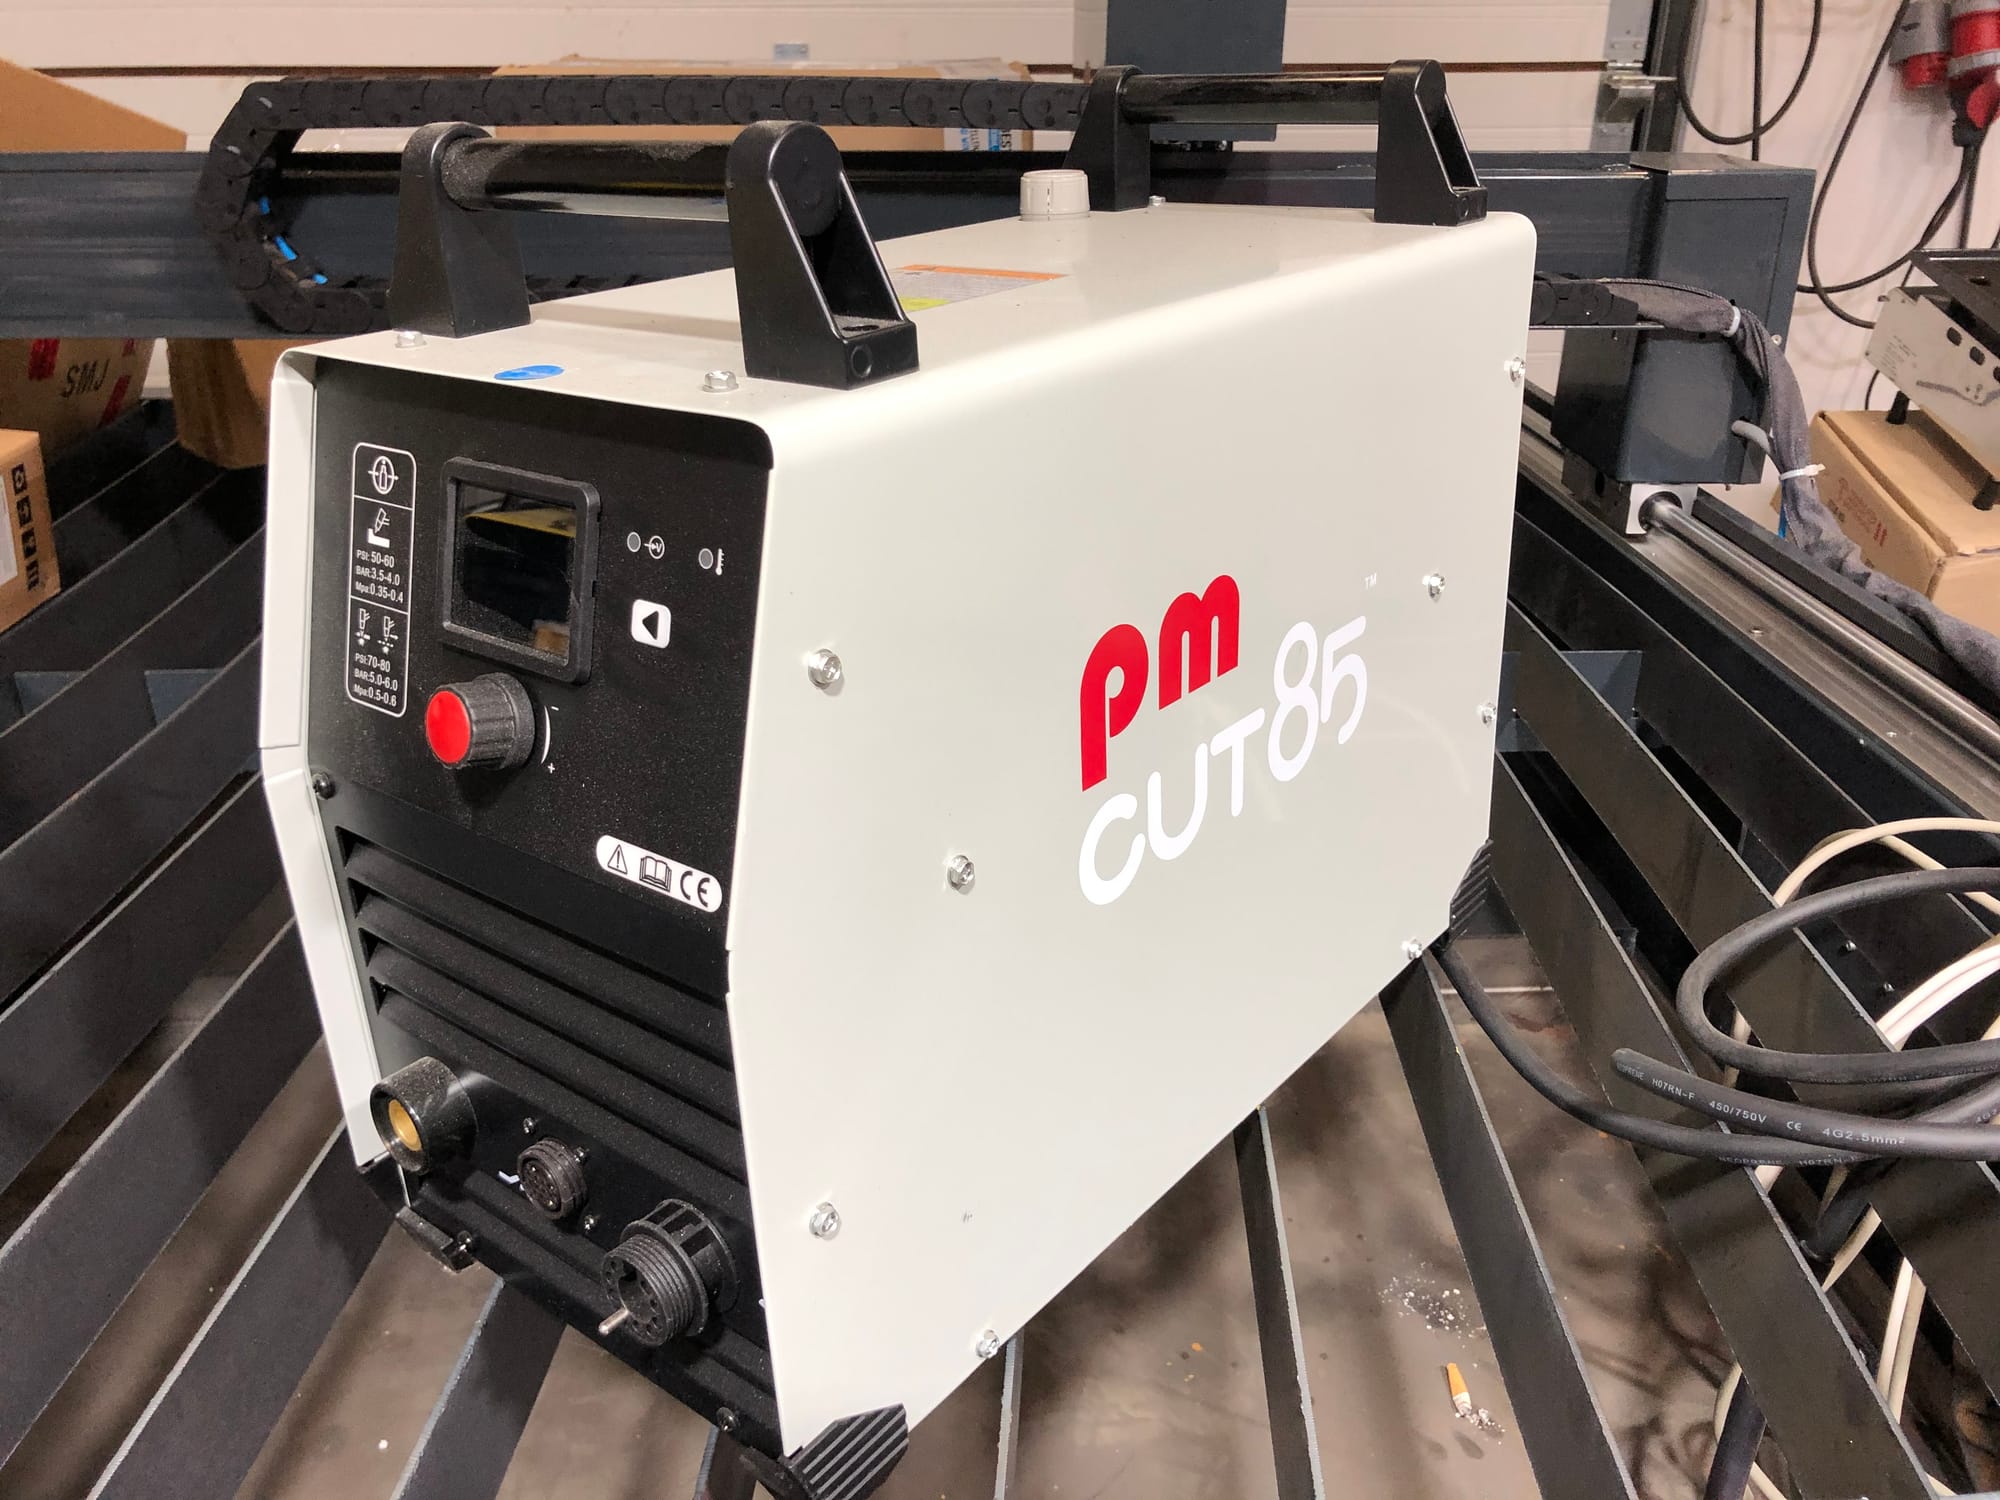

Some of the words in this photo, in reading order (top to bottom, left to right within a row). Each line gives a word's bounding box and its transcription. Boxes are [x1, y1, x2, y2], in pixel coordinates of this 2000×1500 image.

[59, 358, 111, 398] SMJ
[371, 551, 395, 568] 50-60
[1652, 1078, 1696, 1101] H07RN-F
[1709, 1100, 1767, 1125] 450/750V
